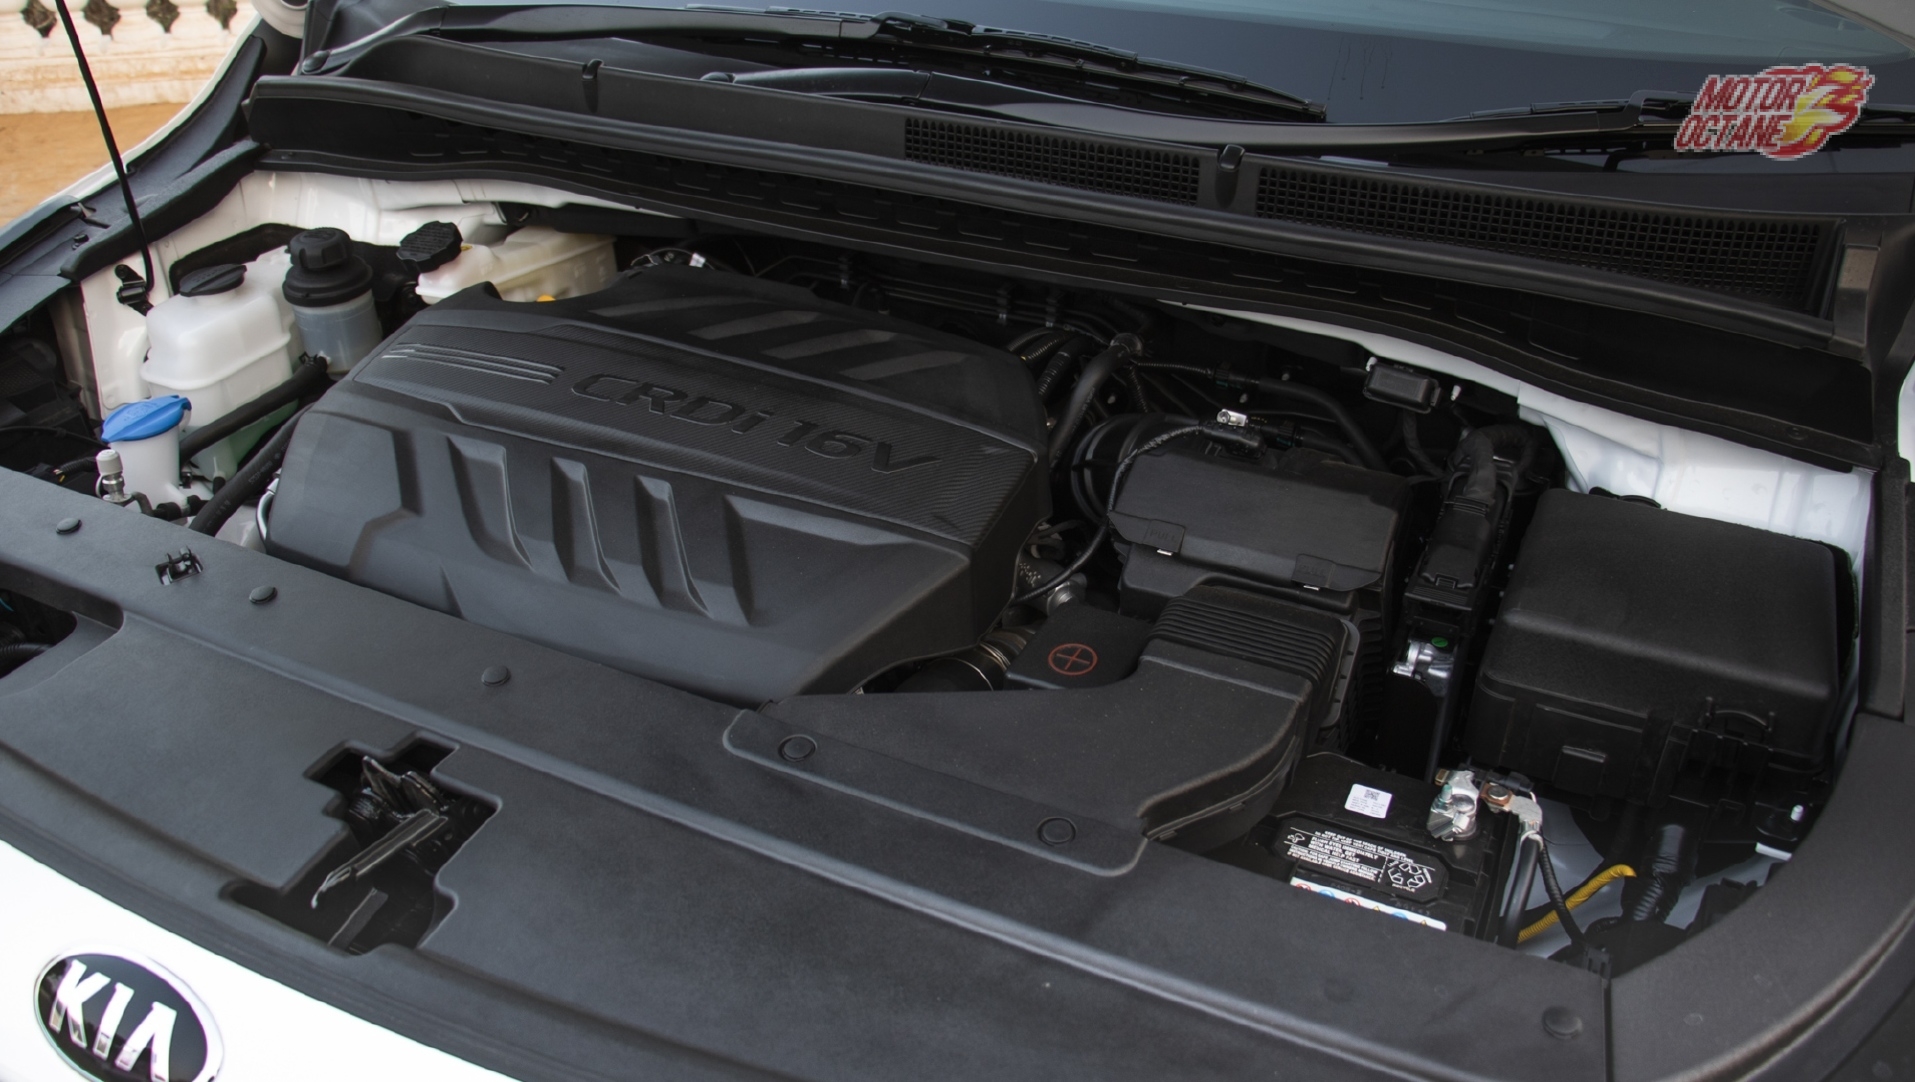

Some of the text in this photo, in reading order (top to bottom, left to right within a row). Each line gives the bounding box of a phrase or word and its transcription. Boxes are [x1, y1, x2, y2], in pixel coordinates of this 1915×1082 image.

[571, 373, 942, 474] CRDi 16V
[49, 959, 177, 1082] KIA
